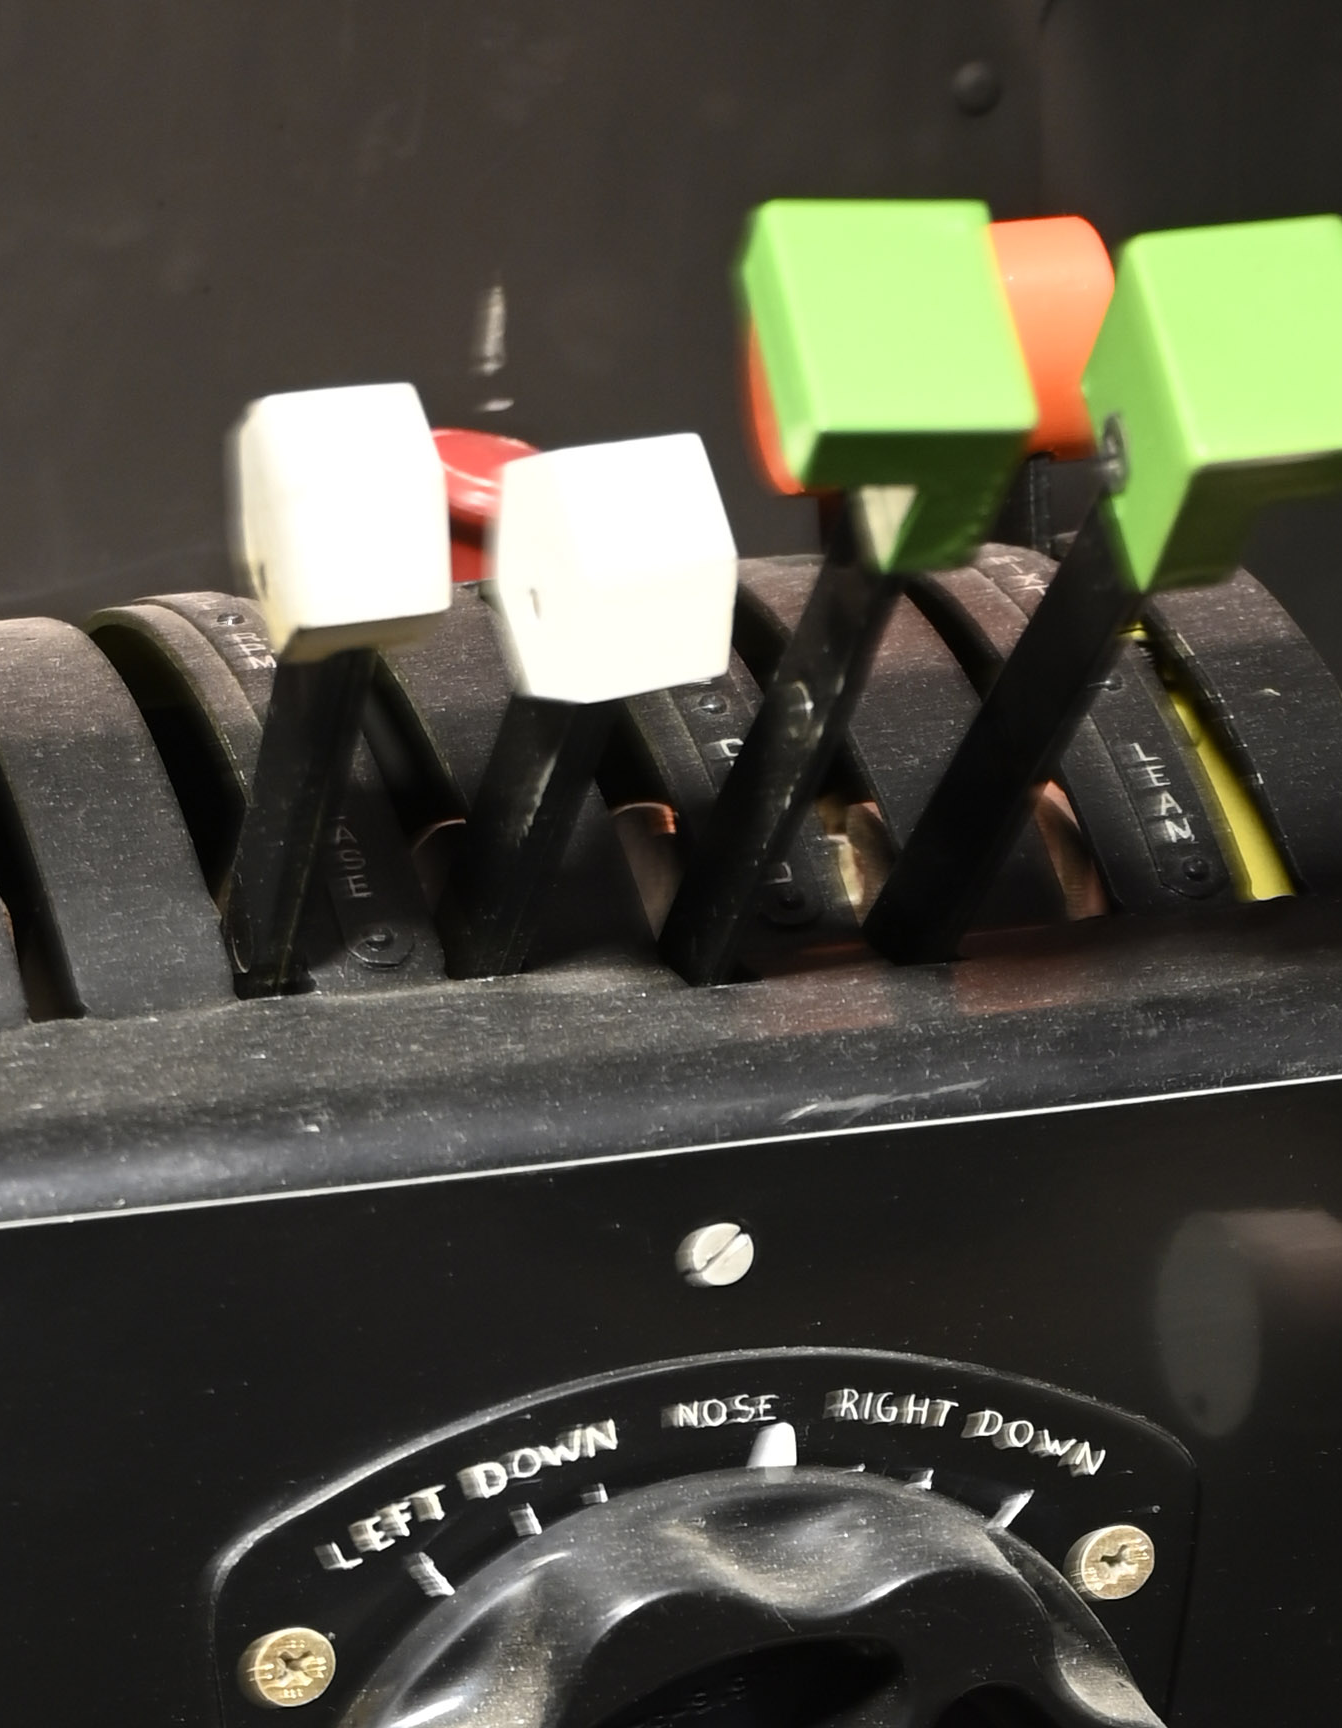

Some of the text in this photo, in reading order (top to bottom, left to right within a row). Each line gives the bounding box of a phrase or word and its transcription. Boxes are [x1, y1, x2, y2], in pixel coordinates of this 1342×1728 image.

[1131, 742, 1196, 843] LEAN
[665, 1393, 780, 1429] NOSE
[831, 1388, 1106, 1477] RIGHT DOWN
[315, 1418, 618, 1571] LEFT DOWN
